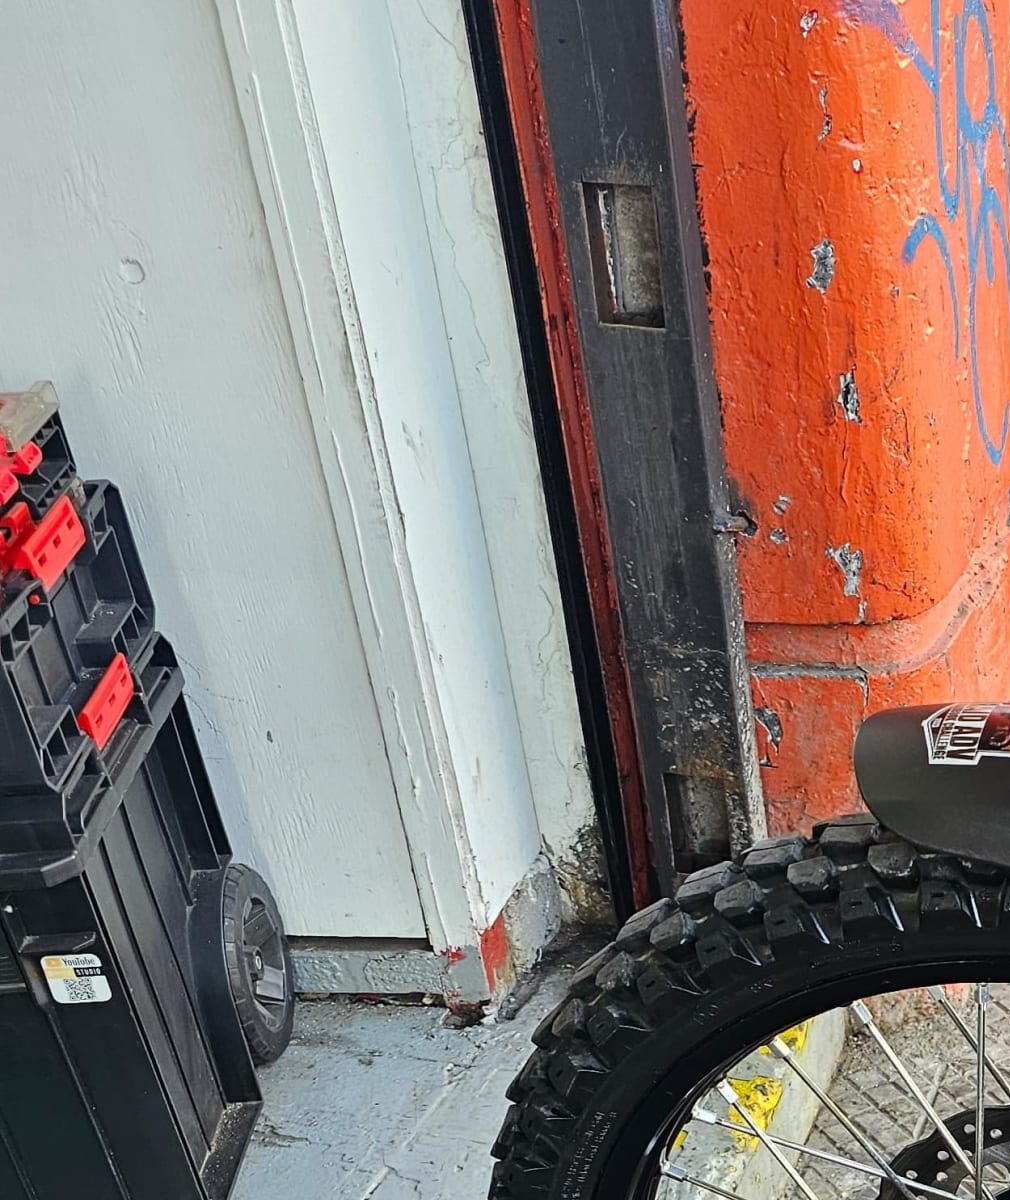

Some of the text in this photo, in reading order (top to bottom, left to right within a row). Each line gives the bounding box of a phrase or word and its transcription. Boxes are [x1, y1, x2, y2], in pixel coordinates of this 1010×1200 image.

[946, 726, 982, 760] ADV
[62, 957, 95, 967] YouTube
[76, 968, 101, 976] STUDIO
